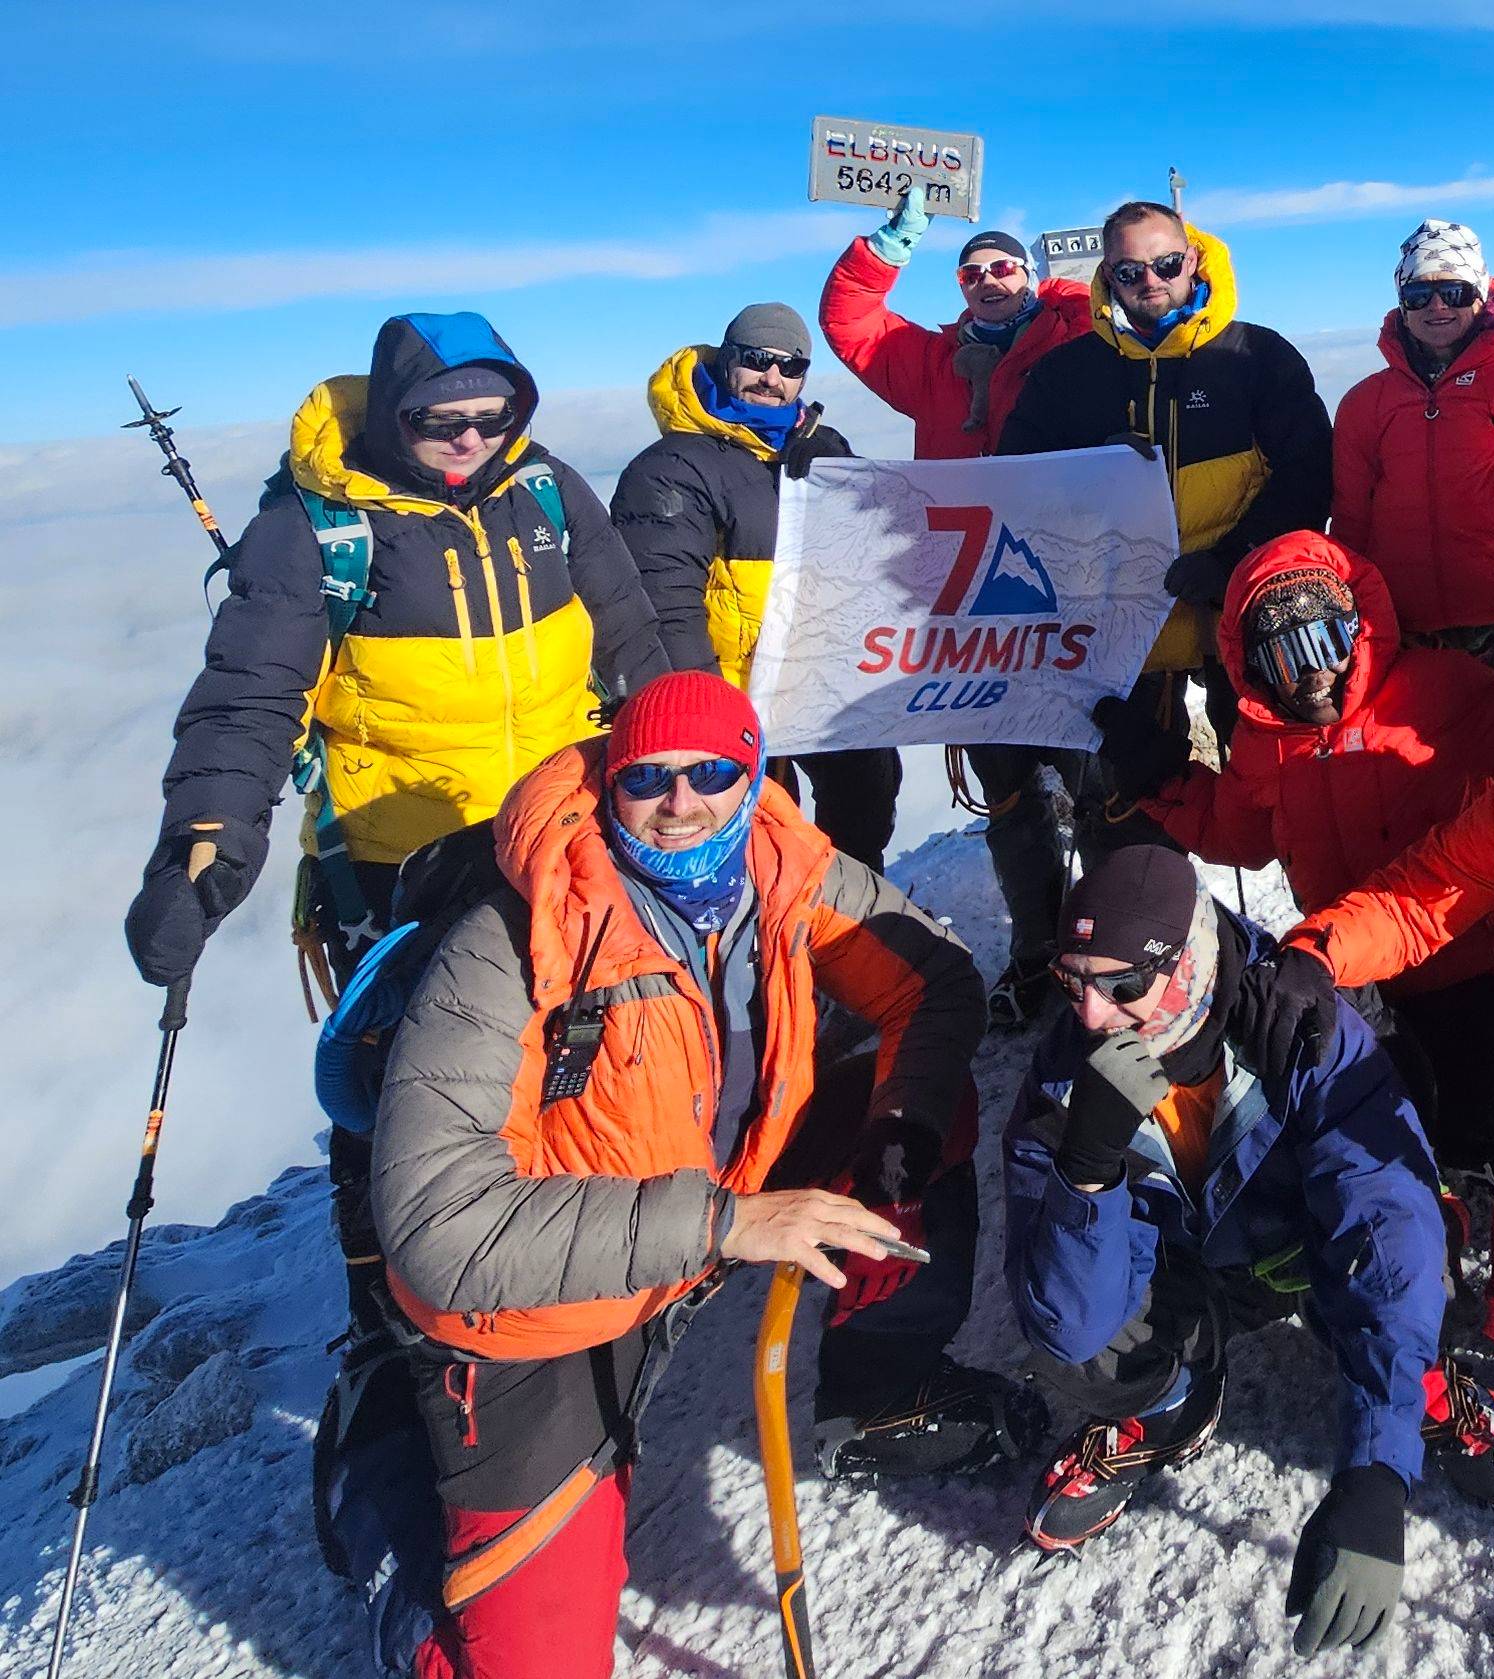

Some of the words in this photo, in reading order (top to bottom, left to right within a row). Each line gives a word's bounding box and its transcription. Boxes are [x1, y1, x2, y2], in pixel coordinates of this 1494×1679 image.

[825, 130, 963, 172] ELBRUS
[837, 165, 912, 197] 5642
[925, 182, 950, 203] m
[925, 505, 993, 616] 7
[856, 622, 1097, 675] SUMMITS
[905, 680, 1009, 713] CLUB
